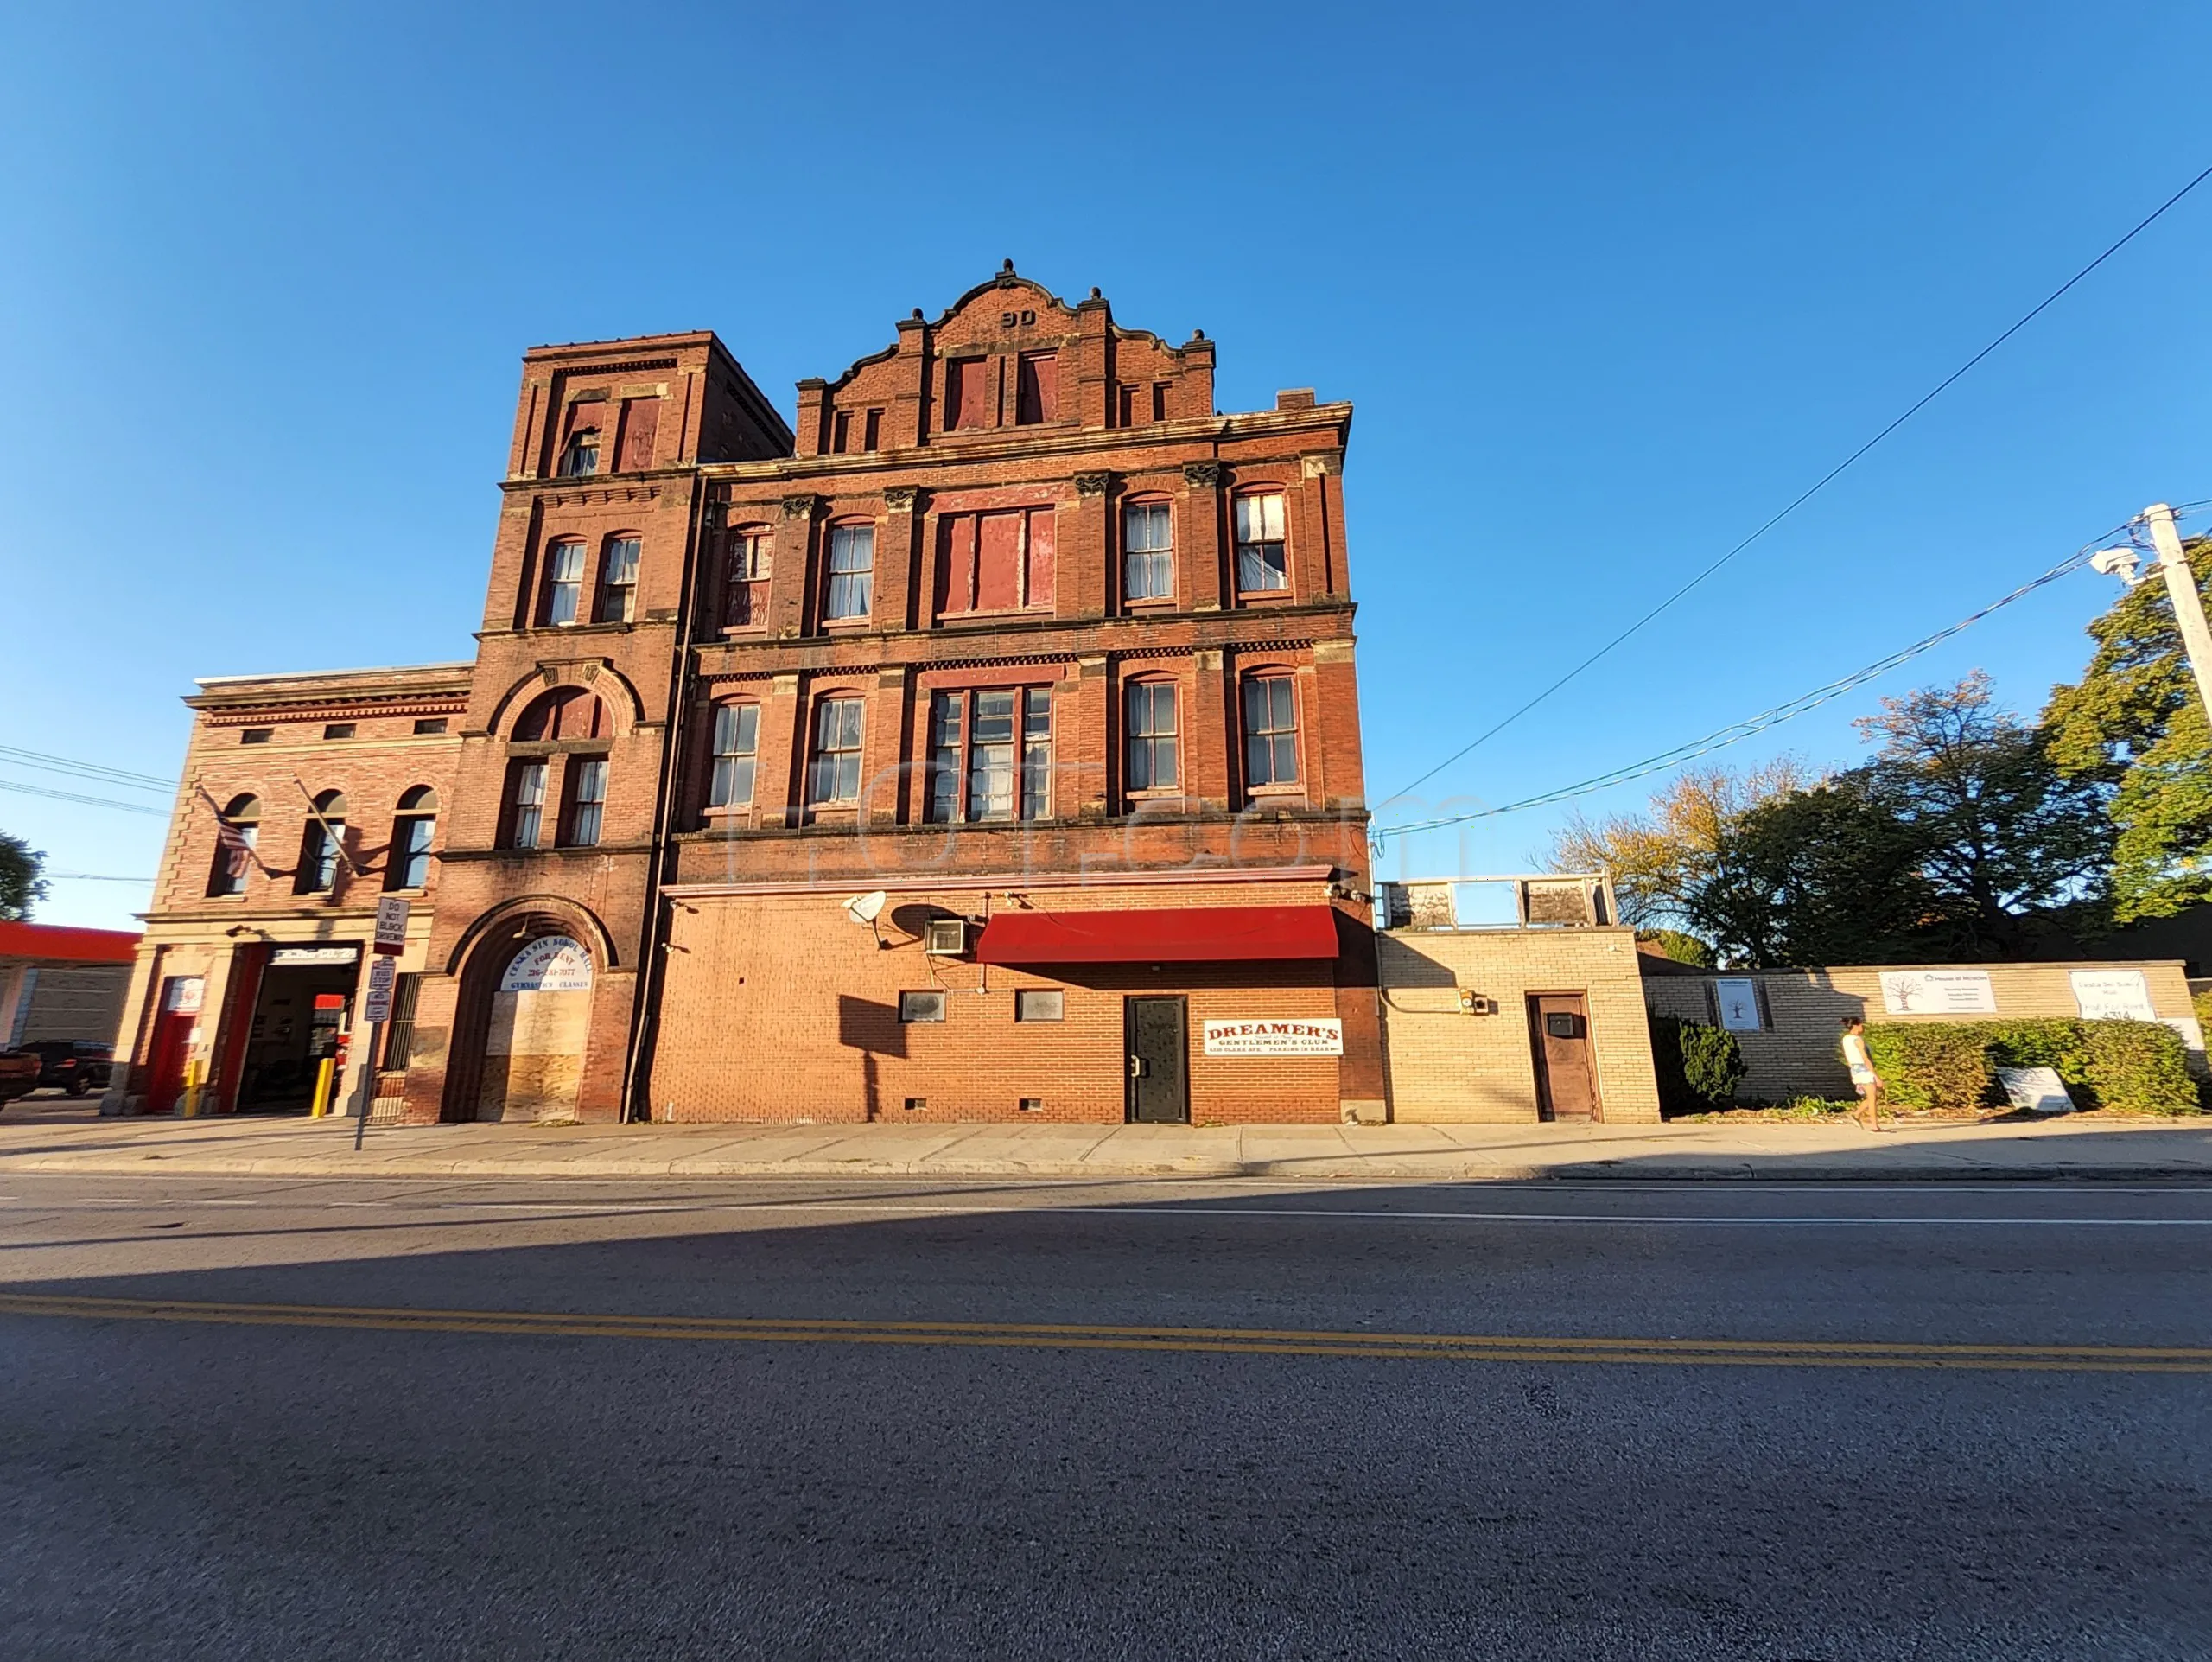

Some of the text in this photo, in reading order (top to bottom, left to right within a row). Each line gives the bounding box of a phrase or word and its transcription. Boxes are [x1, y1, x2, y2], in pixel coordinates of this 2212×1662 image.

[388, 902, 400, 911] DO
[385, 913, 401, 921] NOT
[531, 939, 549, 952] SIN
[553, 938, 579, 952] SOKOL
[579, 951, 593, 975] HALL
[533, 952, 576, 965] FOR RENT
[1207, 1023, 1339, 1041] DREAMER'S
